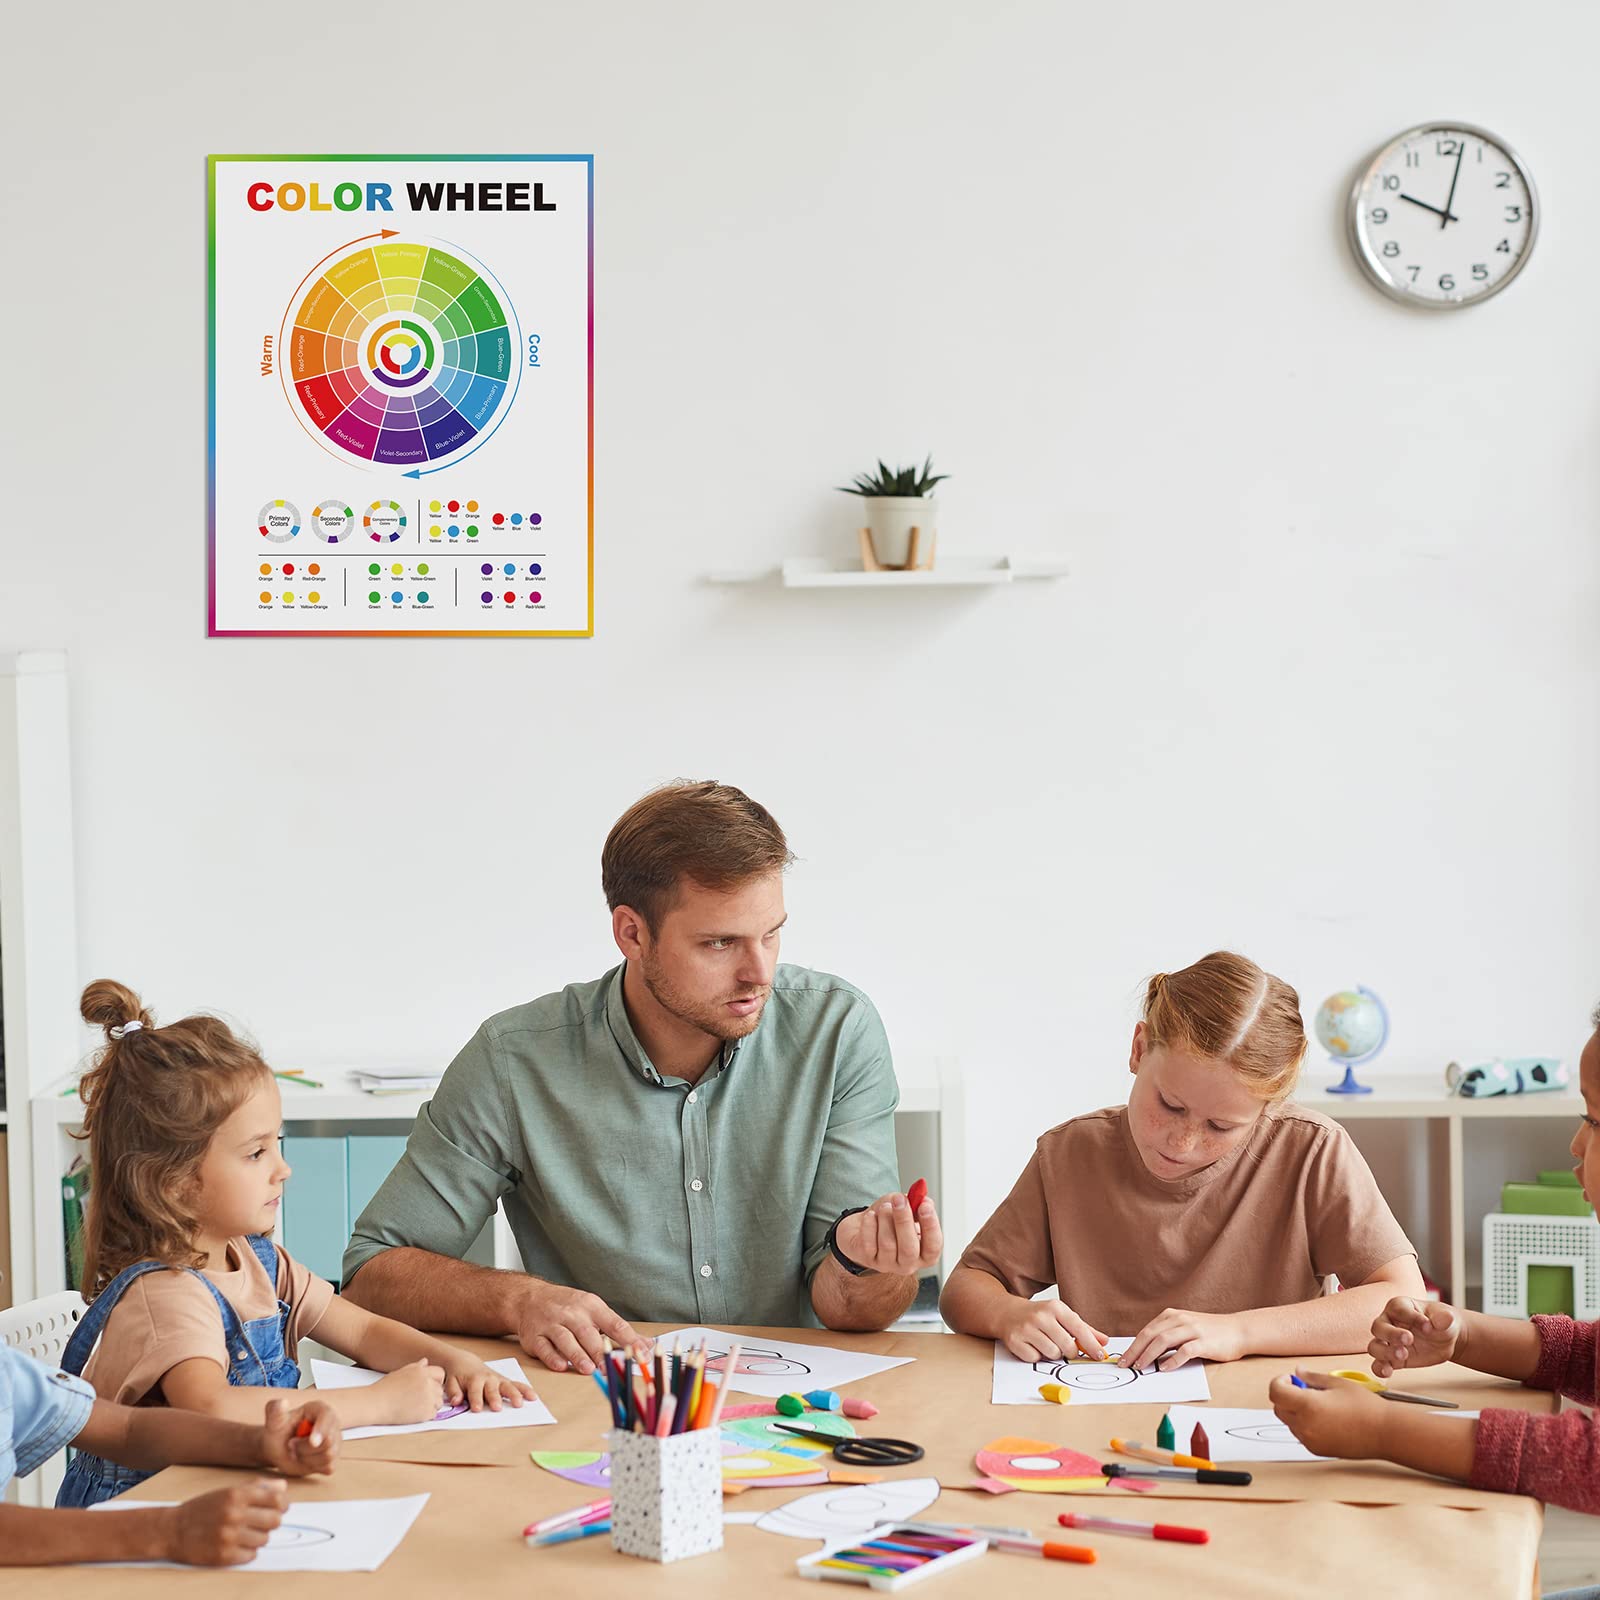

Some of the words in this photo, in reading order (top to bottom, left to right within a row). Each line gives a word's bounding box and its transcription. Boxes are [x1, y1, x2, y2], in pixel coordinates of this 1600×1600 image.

[1436, 140, 1458, 156] 12
[1477, 147, 1482, 163] 1
[1406, 152, 1419, 168] 11
[1382, 175, 1400, 191] 10
[1495, 172, 1510, 188] 2
[247, 182, 394, 211] COLOR
[406, 182, 557, 211] WHEEL
[1371, 207, 1389, 225] 9
[1504, 206, 1521, 223] 3
[1383, 241, 1400, 258] 8
[1495, 239, 1510, 253] 4
[433, 255, 468, 281] Yellow-Green
[1406, 265, 1421, 283] 7
[1471, 263, 1488, 281] 5
[1438, 274, 1455, 291] 6
[260, 335, 273, 376] Warm
[297, 334, 306, 373] Red-Orange
[497, 337, 505, 373] Blue-Green
[528, 334, 541, 367] Cool
[303, 385, 326, 420] Red-Primary
[474, 383, 498, 421] Blue-Primary
[335, 428, 365, 450] Red-Violet
[434, 429, 466, 450] Blue-Violet
[379, 448, 424, 457] Violet-Secondary
[268, 515, 291, 523] Primary
